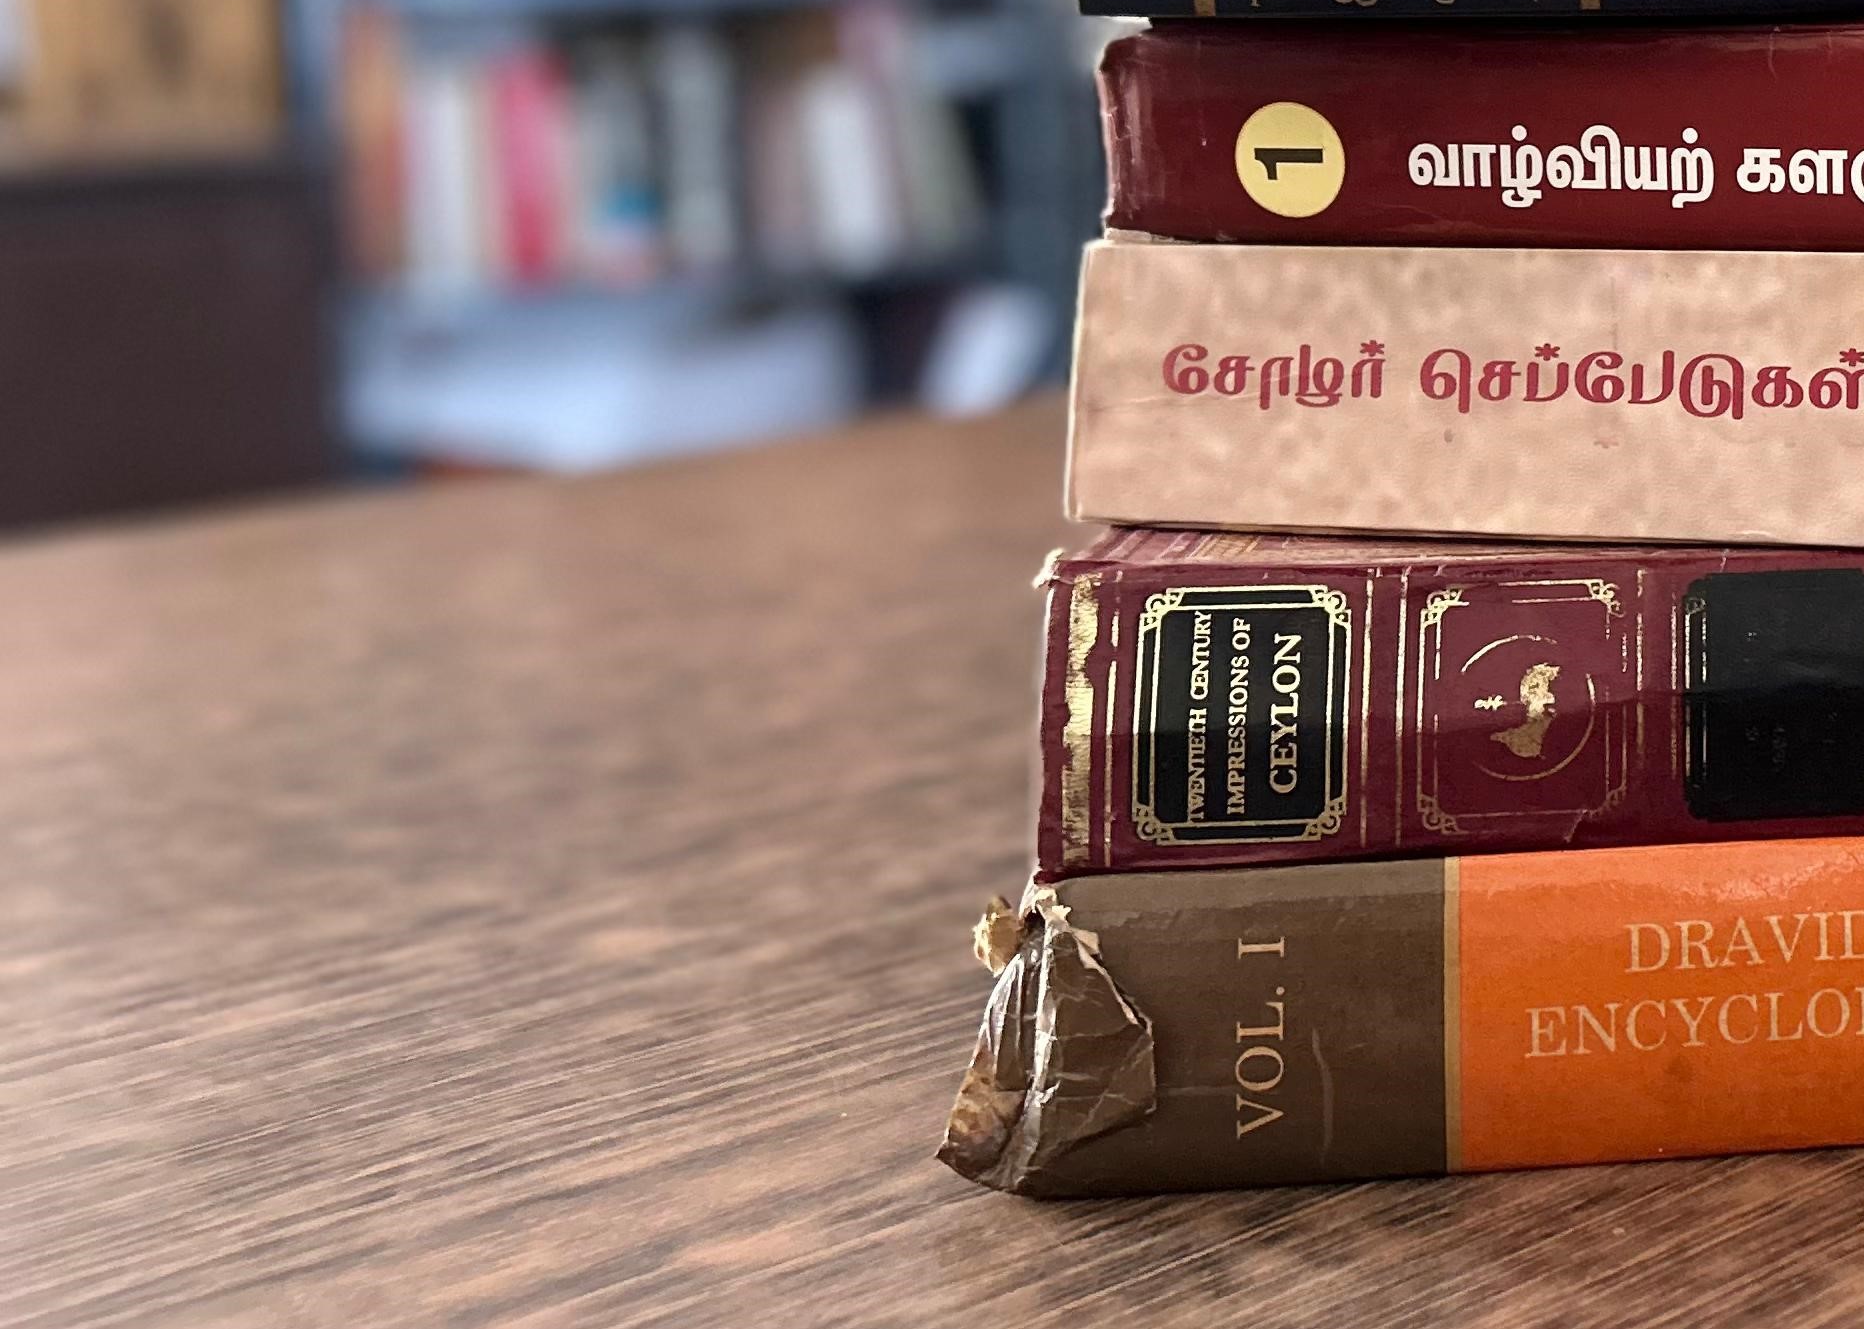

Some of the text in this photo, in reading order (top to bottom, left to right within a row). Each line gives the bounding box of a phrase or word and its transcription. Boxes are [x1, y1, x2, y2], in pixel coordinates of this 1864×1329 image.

[1253, 146, 1324, 181] 1
[1408, 124, 1717, 209] வாழ்வியற்
[1161, 338, 1387, 411] சோழர்
[1189, 610, 1212, 701] CENTURY
[1226, 617, 1251, 815] IMPRESSIONS OF
[1268, 632, 1303, 794] CEYLON
[1234, 935, 1286, 1140] VOL. I
